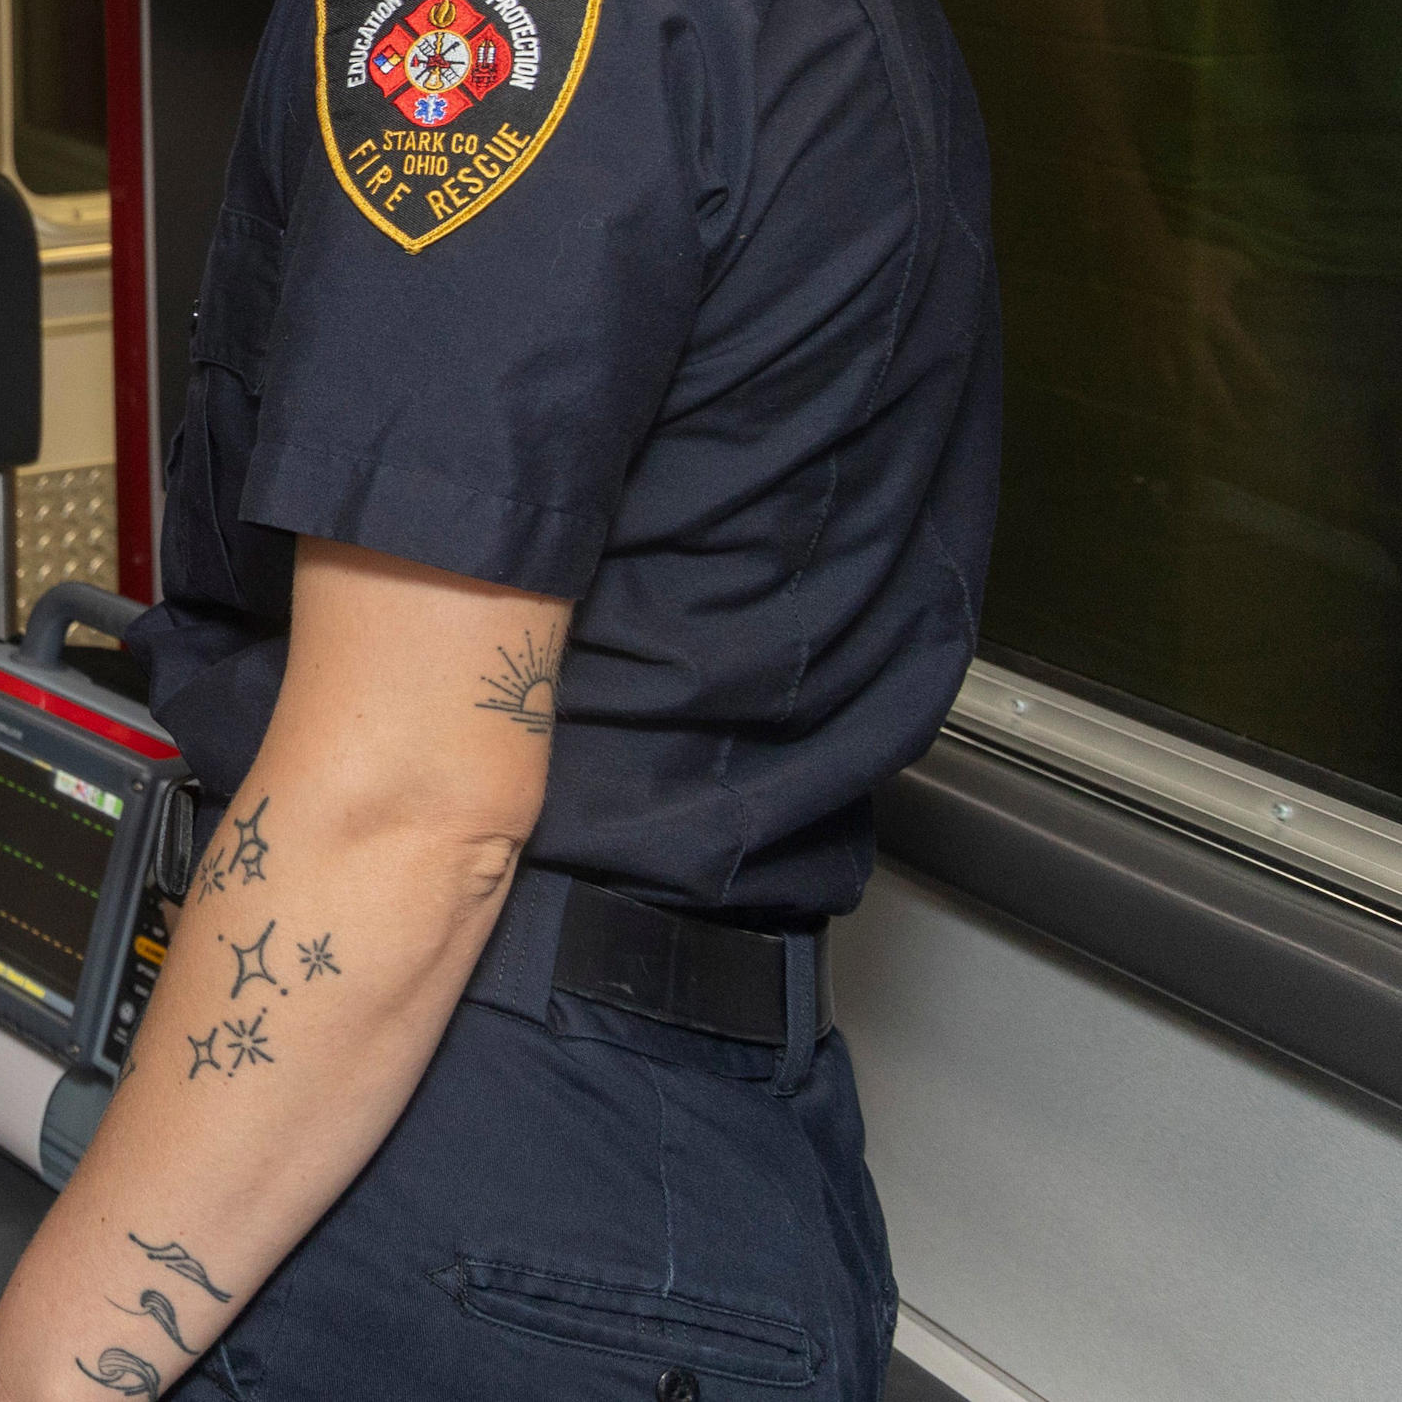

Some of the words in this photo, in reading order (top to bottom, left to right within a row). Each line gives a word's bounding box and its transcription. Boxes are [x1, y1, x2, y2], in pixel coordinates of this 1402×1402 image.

[383, 129, 446, 154] STARK
[451, 132, 477, 155] CO
[349, 138, 411, 212] FIRE
[425, 123, 531, 221] RESCUE
[403, 155, 448, 177] OHIO
